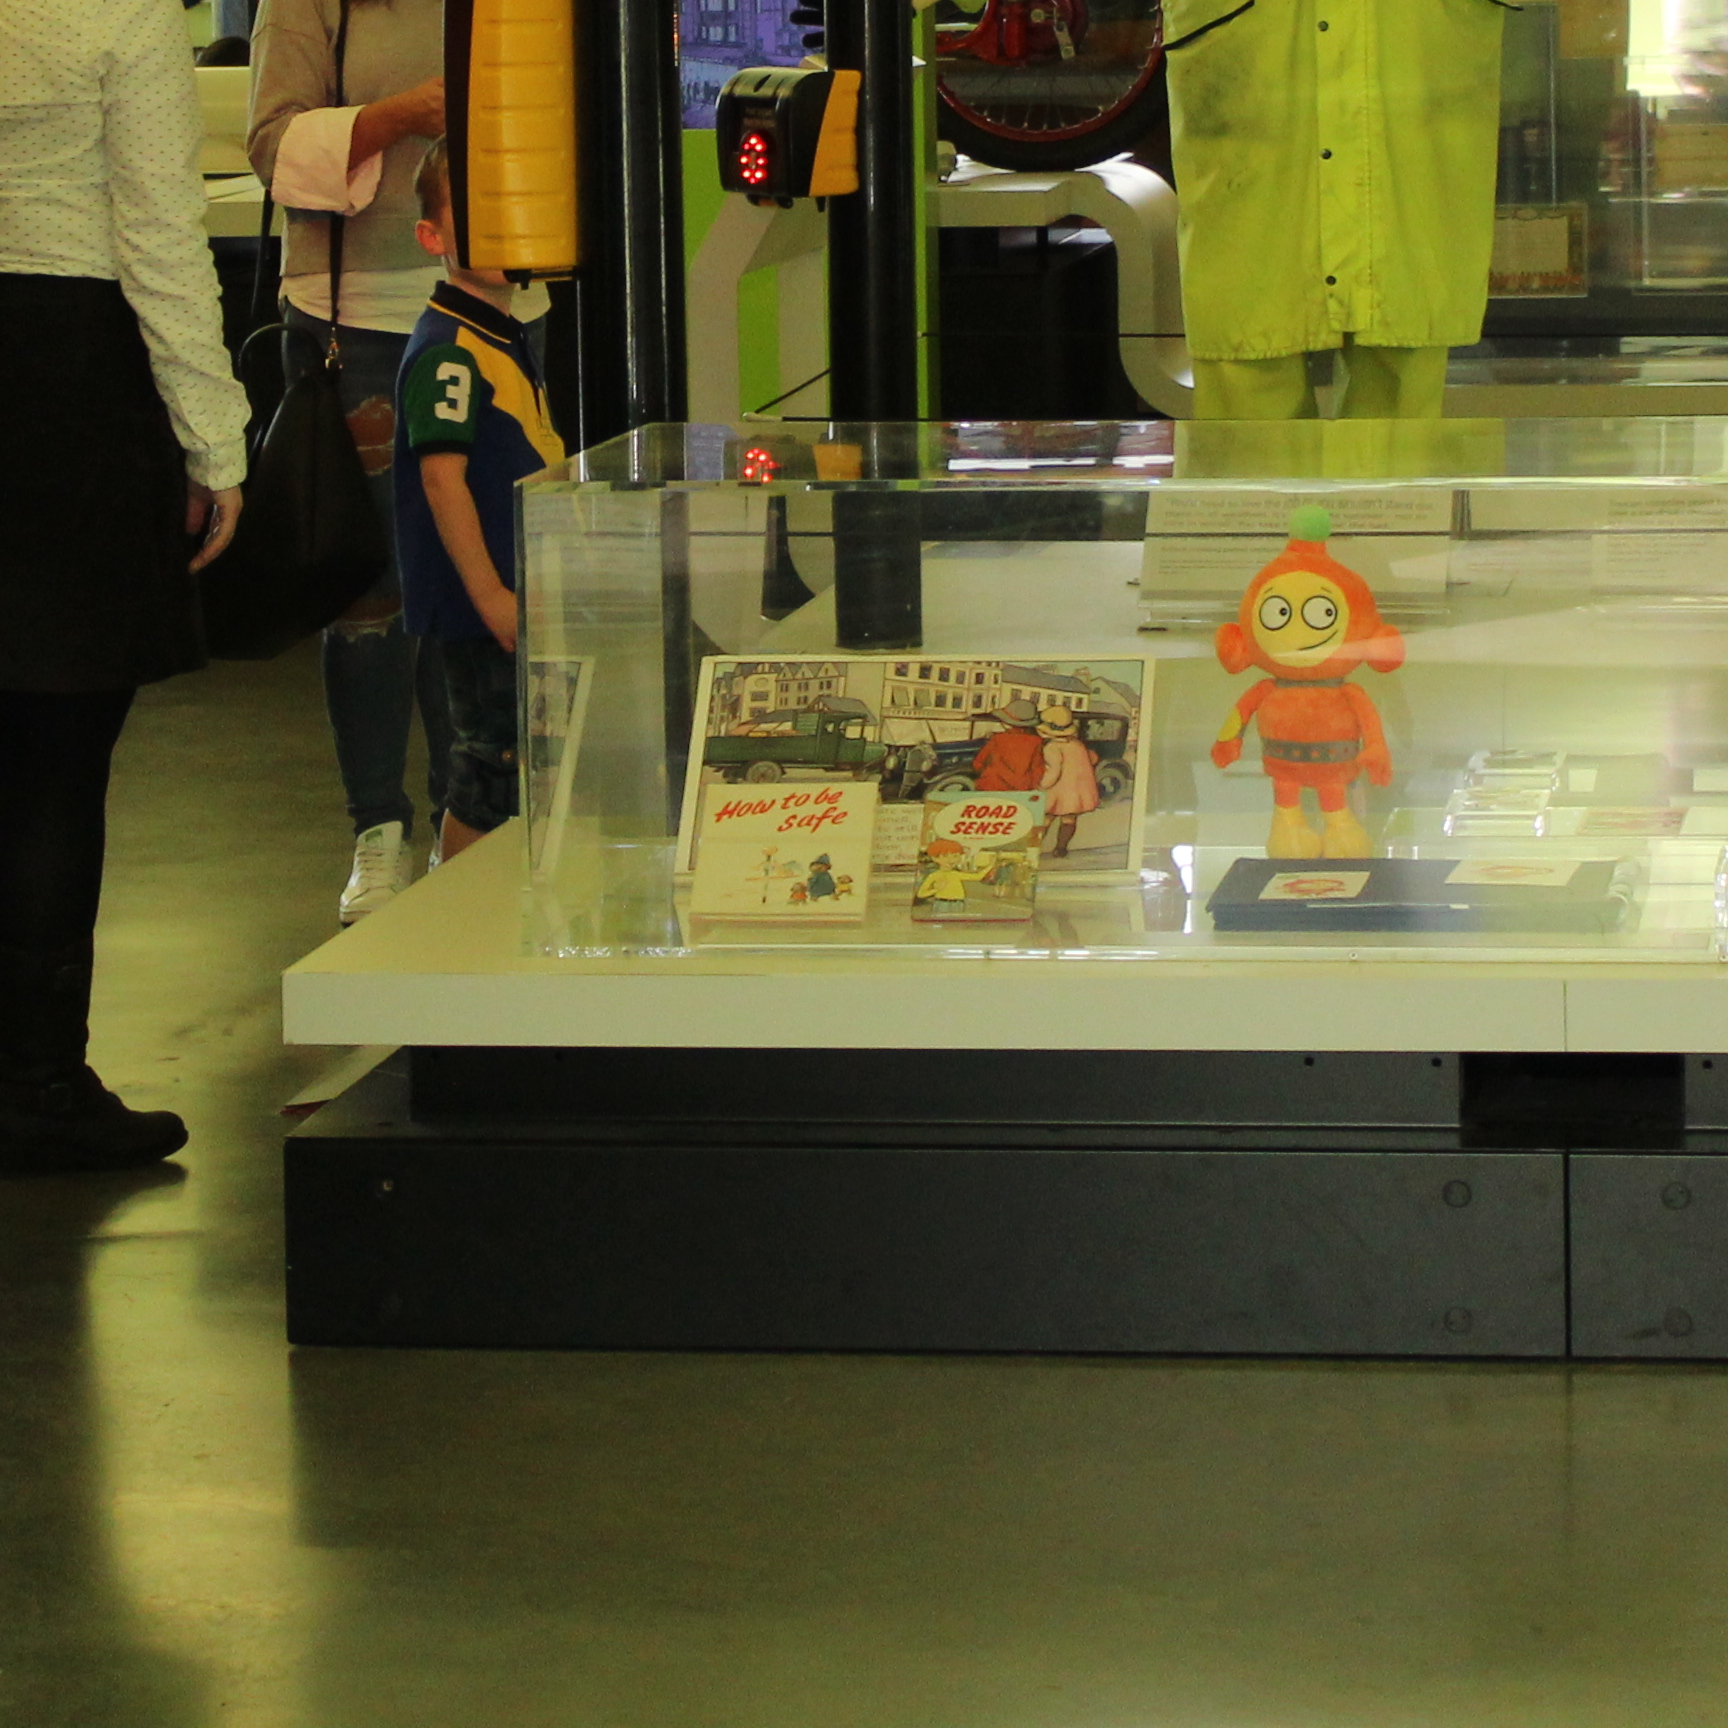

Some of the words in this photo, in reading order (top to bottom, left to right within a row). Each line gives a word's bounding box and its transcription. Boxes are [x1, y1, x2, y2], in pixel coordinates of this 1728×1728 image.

[434, 361, 472, 423] 3
[715, 799, 776, 823] How
[780, 792, 811, 810] to
[814, 787, 844, 805] be
[960, 804, 1019, 819] ROAD
[777, 806, 848, 834] safe
[950, 821, 1018, 835] SENSE
